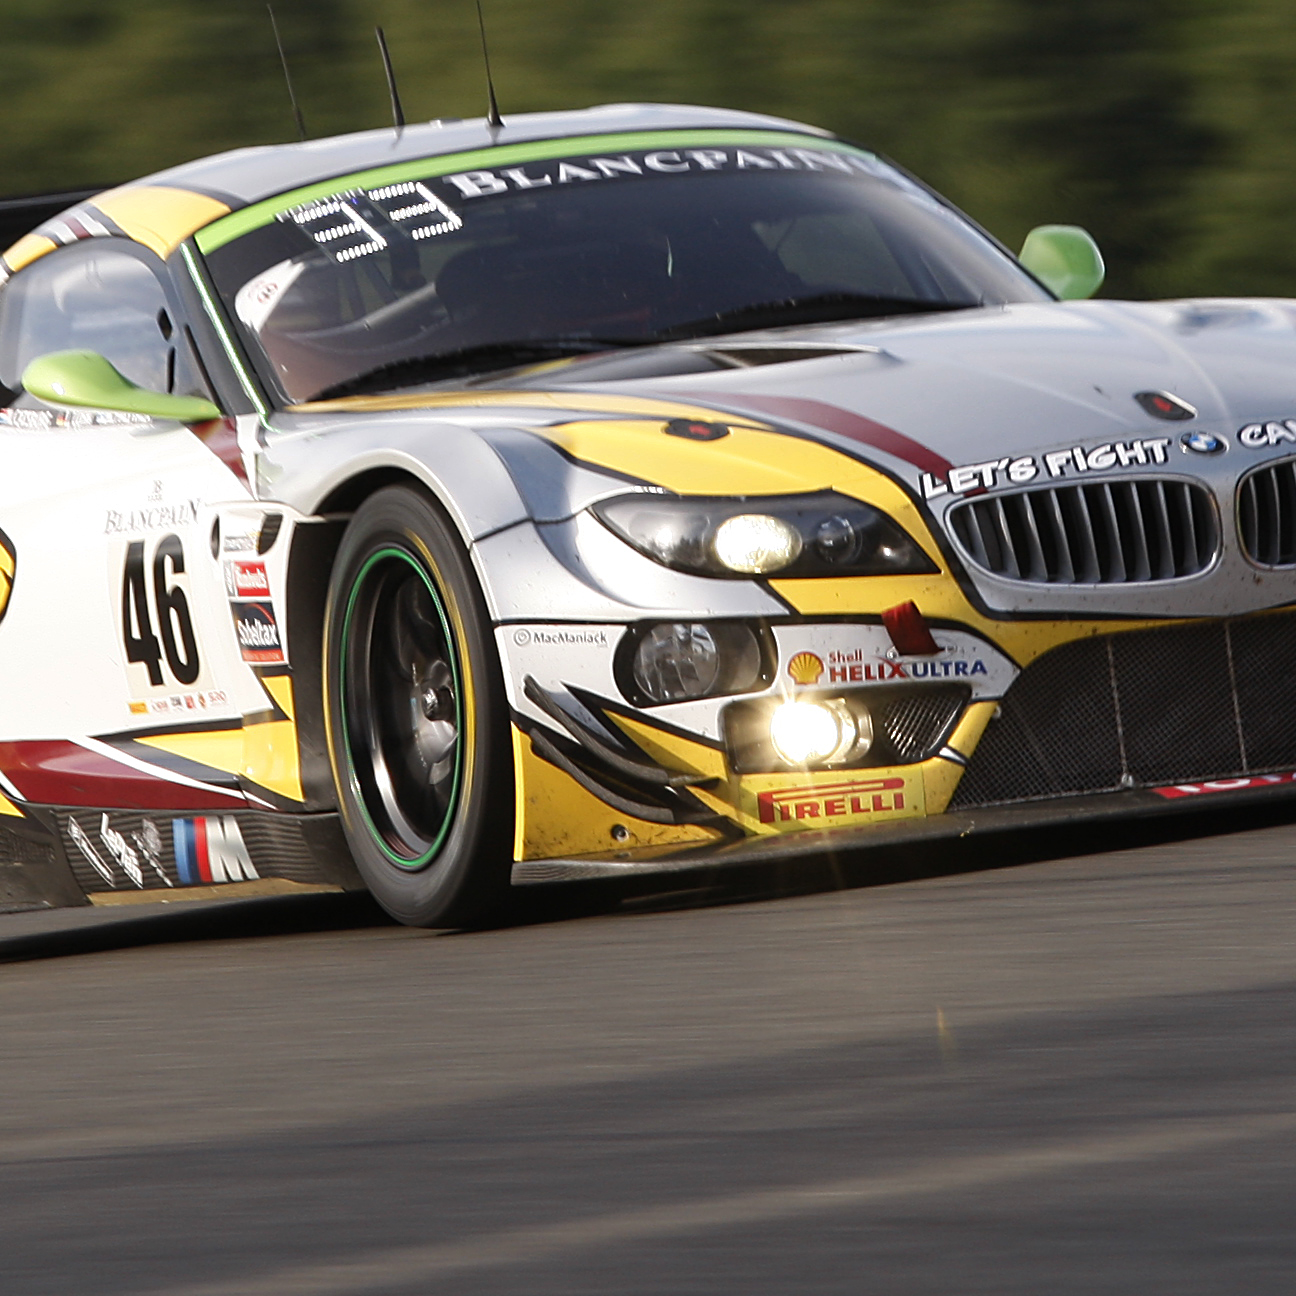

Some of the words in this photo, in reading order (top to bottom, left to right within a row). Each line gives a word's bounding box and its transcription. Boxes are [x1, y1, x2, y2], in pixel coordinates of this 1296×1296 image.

[443, 150, 856, 200] BLANCPAIN
[919, 456, 1039, 502] LET'S
[1043, 436, 1171, 479] FIGHT
[121, 532, 200, 687] 46
[828, 648, 863, 664] Shell
[828, 655, 909, 684] HELIX
[911, 660, 988, 679] ULTRA
[758, 777, 905, 824] PIRELLI
